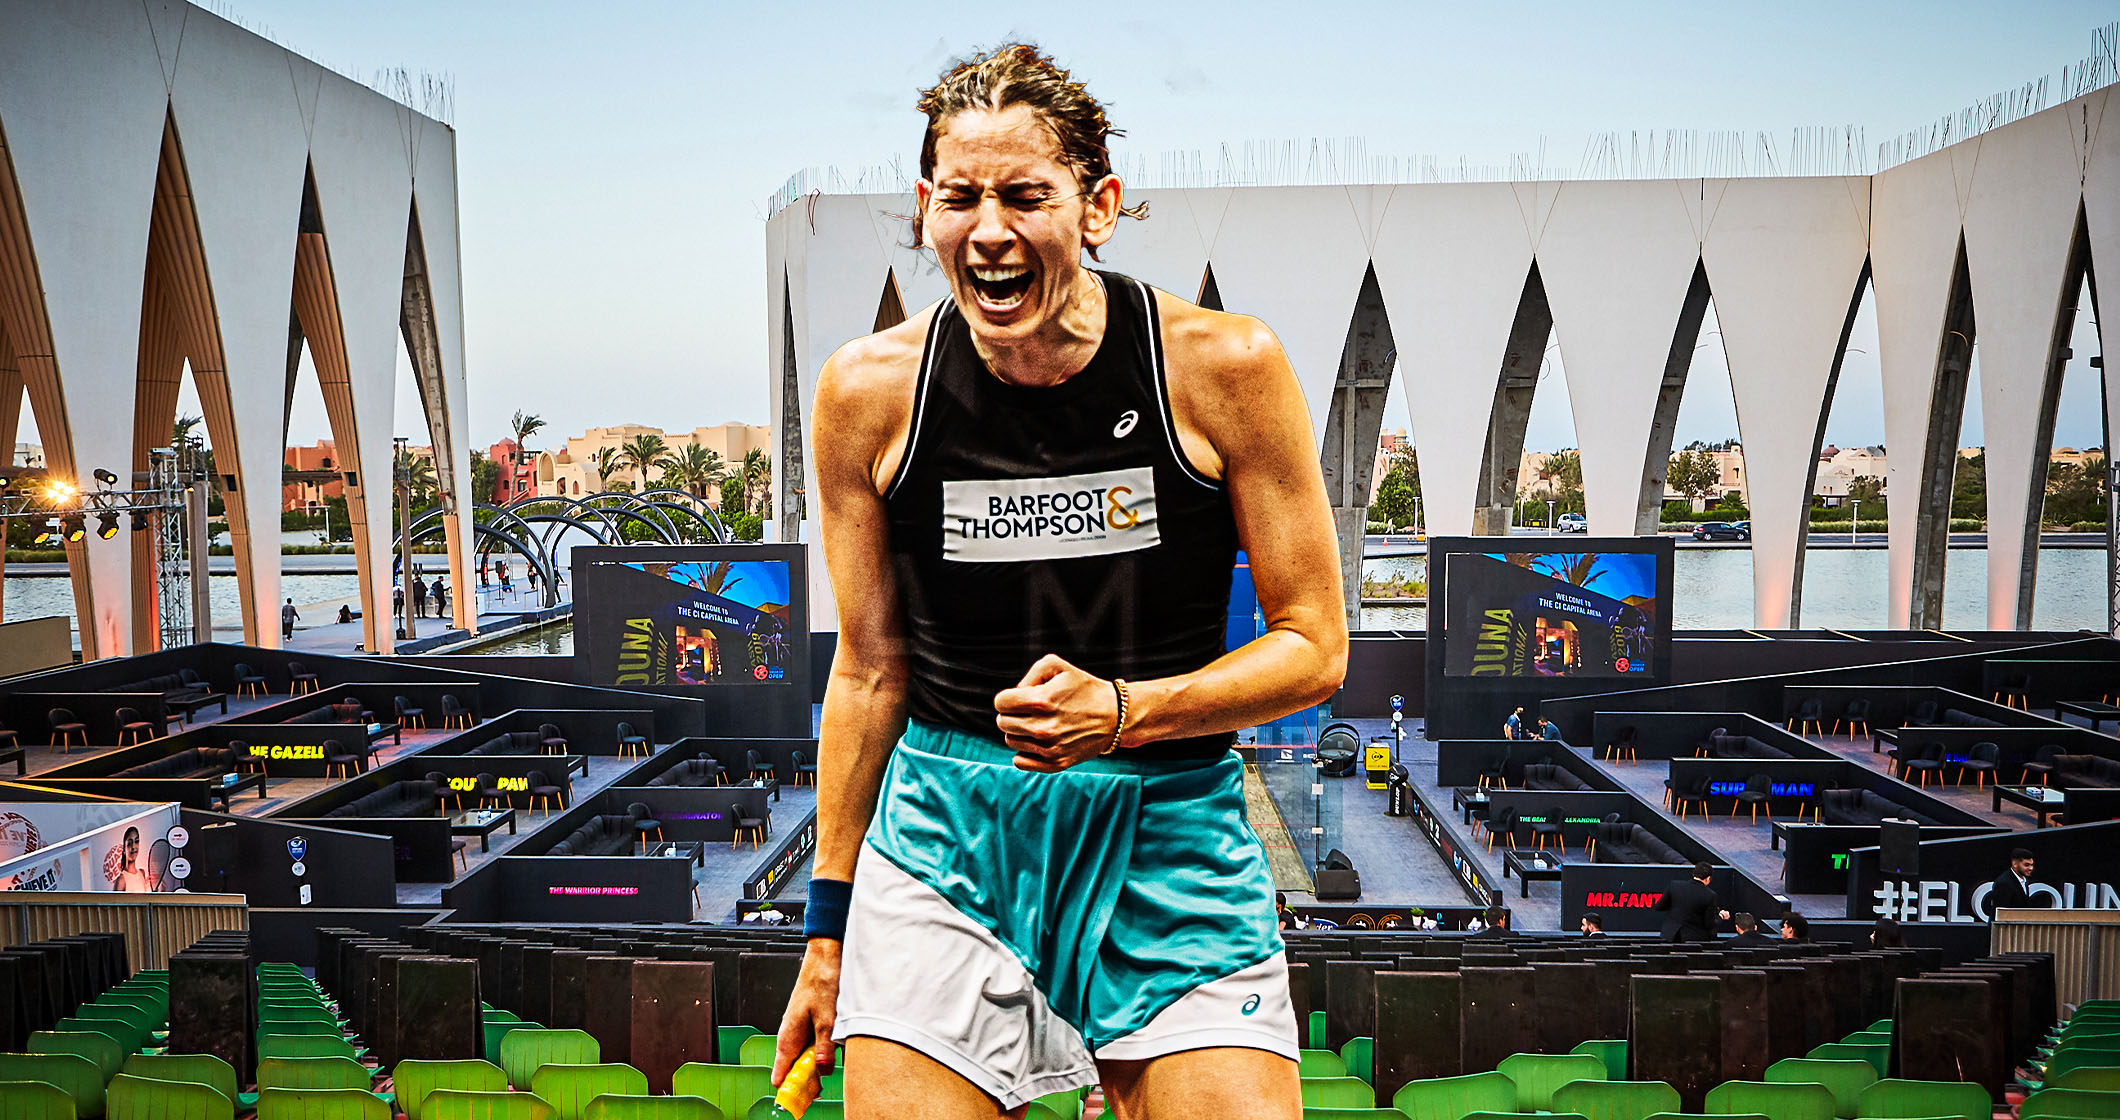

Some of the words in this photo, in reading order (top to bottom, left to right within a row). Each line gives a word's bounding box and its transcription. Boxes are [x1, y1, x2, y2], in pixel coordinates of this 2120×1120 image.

[989, 489, 1107, 516] BARFOOT
[1106, 486, 1139, 530] &
[958, 511, 1106, 539] THOMPSON
[693, 600, 721, 614] WELCOME
[1538, 597, 1553, 608] THE
[1554, 601, 1562, 610] CI
[1563, 603, 1586, 615] CAPITAL
[1555, 592, 1584, 606] WELCOME
[677, 606, 692, 617] THE
[692, 609, 700, 618] CI
[700, 611, 724, 623] CAPITAL
[249, 745, 269, 759] HE
[270, 745, 325, 760] GAZELL
[7, 873, 49, 891] CHIEVE
[549, 886, 564, 895] THE
[564, 886, 602, 895] WARRIOR
[601, 886, 639, 896] PRINCESS
